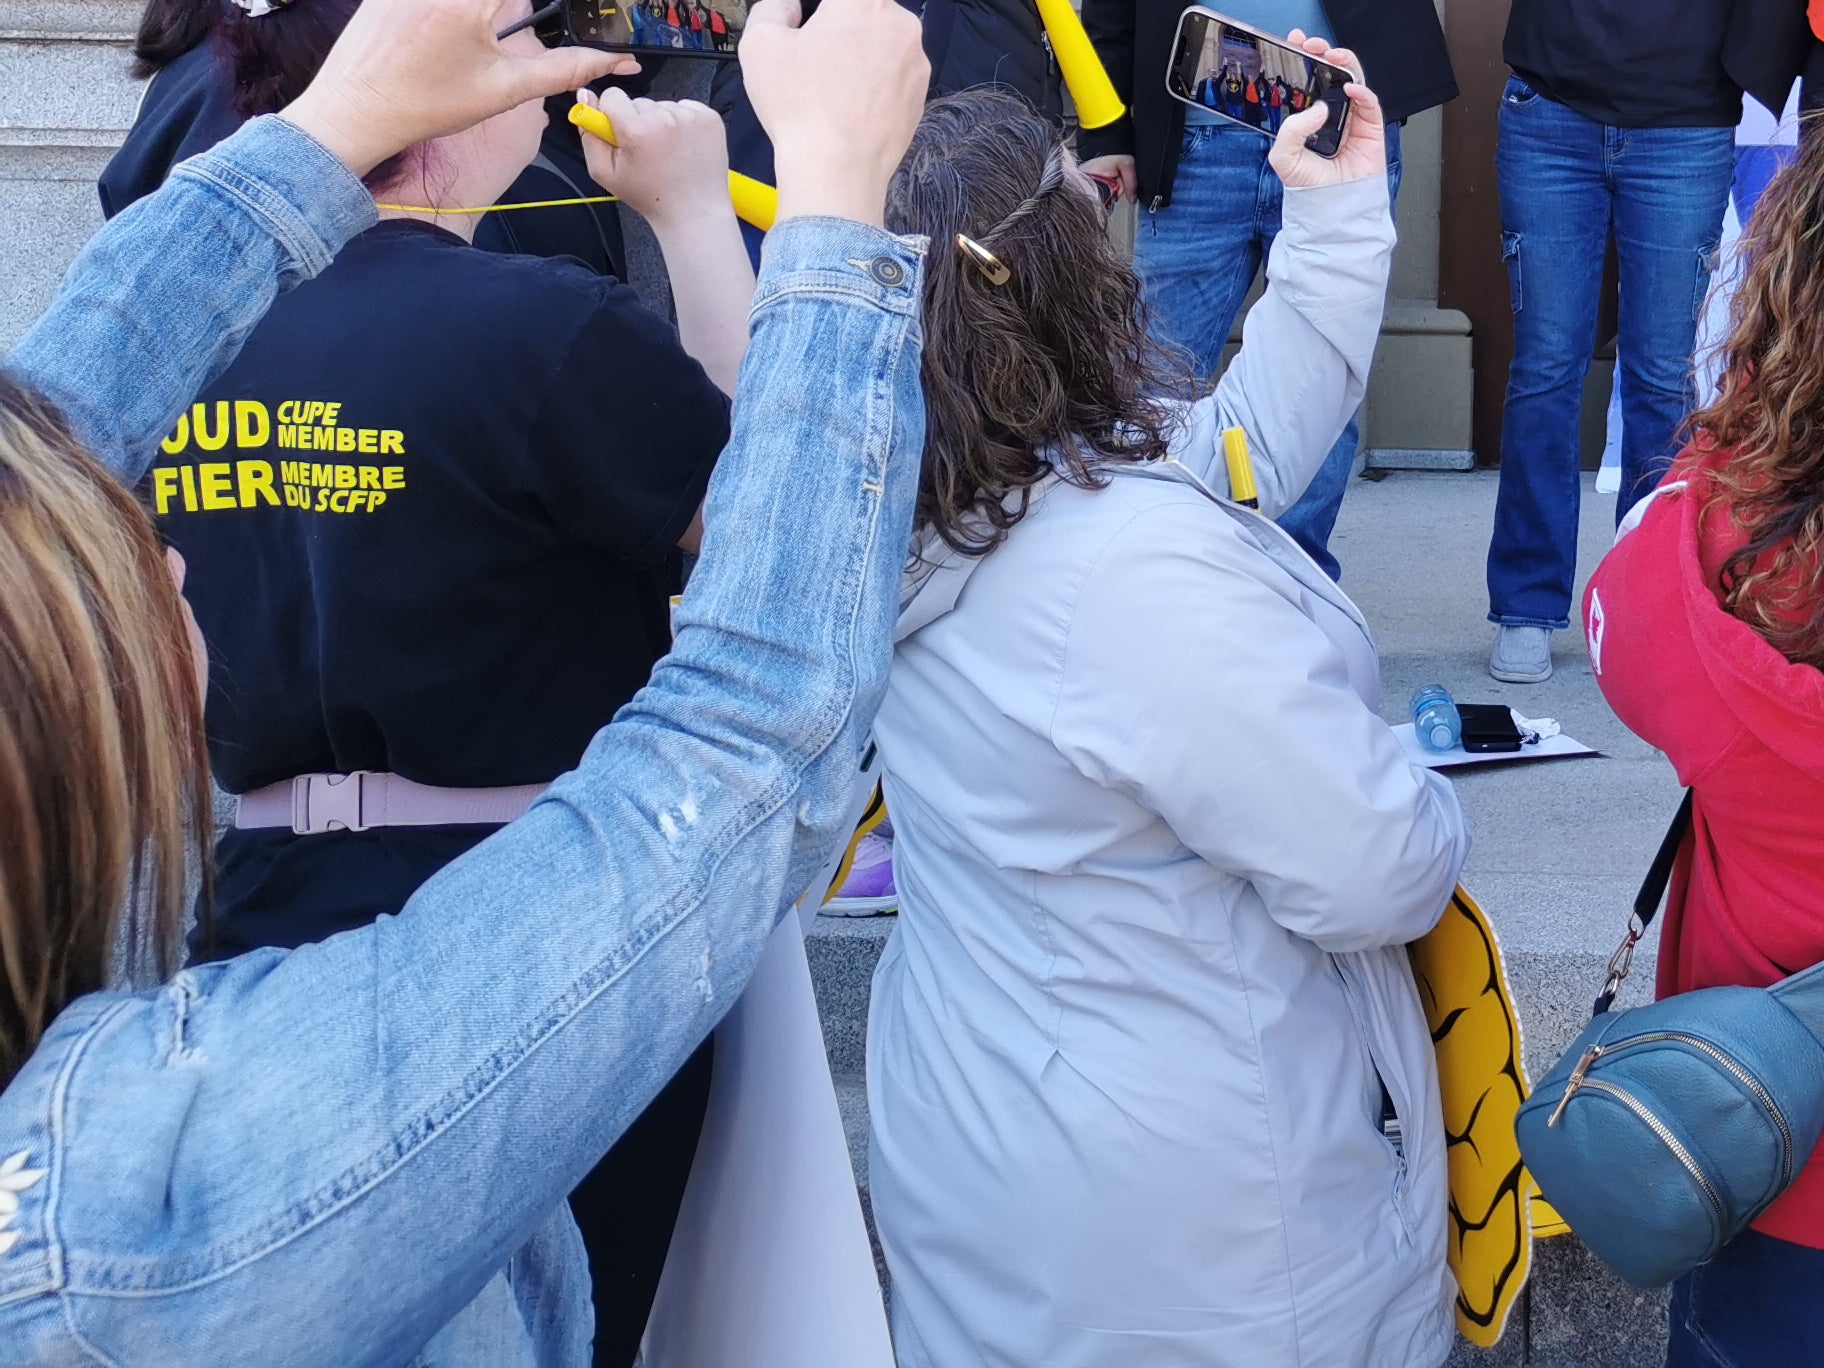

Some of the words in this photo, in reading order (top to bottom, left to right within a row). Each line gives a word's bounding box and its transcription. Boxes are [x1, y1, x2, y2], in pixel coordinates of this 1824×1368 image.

[277, 400, 341, 426] CUPE
[161, 400, 270, 455] OUD
[278, 425, 405, 454] MEMBER
[153, 460, 281, 514] FIER
[281, 461, 406, 489] MEMBRE
[284, 485, 311, 510] DU
[315, 489, 387, 513] SCFP
